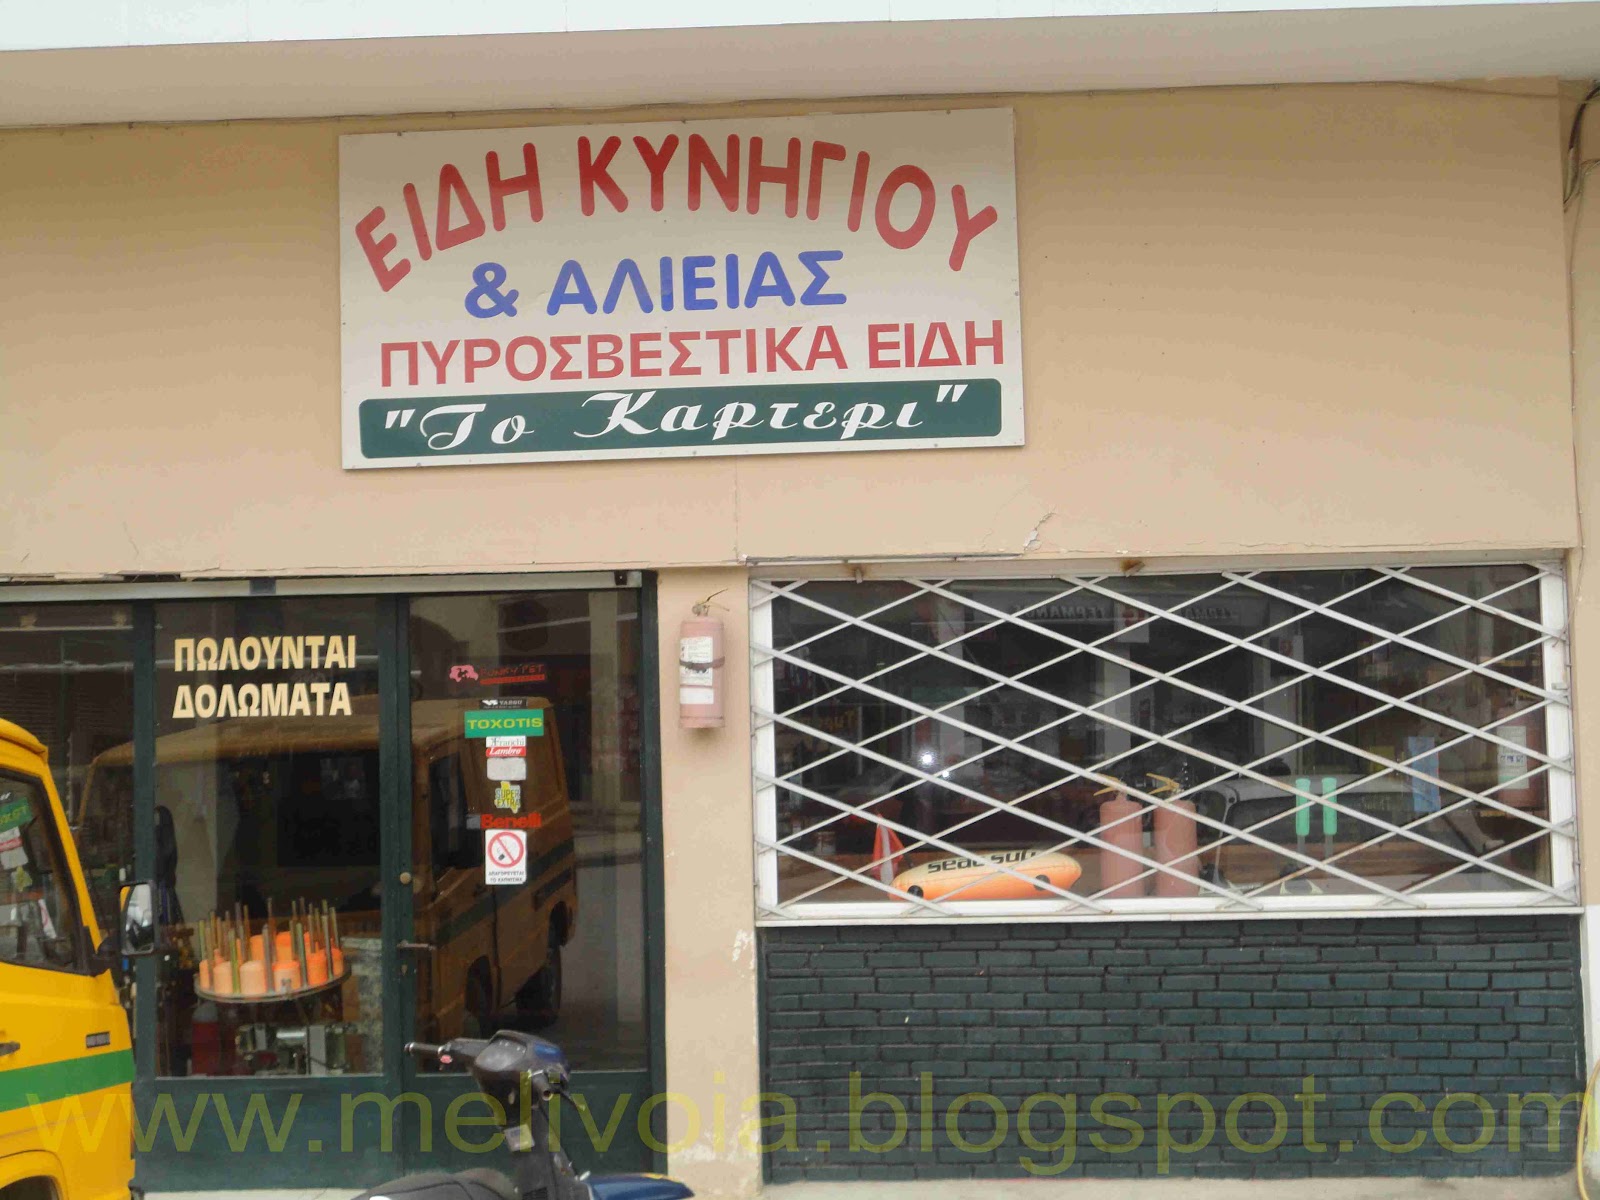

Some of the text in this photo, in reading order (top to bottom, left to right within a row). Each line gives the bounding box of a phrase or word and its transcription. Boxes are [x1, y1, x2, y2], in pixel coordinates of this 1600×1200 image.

[354, 133, 999, 293] ΕΙΔΗ ΚΥΝΗΓΙΟΥ
[464, 249, 848, 319] & ΑΛΙΕΙΑΣ
[380, 319, 1004, 388] ΠΥΡΟΣΒΕΣΤΙΚΑ ΕΙΔΗ
[173, 634, 357, 673] ΠΩΛΟΥΝΤΑΙ
[171, 681, 353, 720] ΔΟΛΩΜΑΤΑ
[467, 718, 543, 730] TOXOTIS
